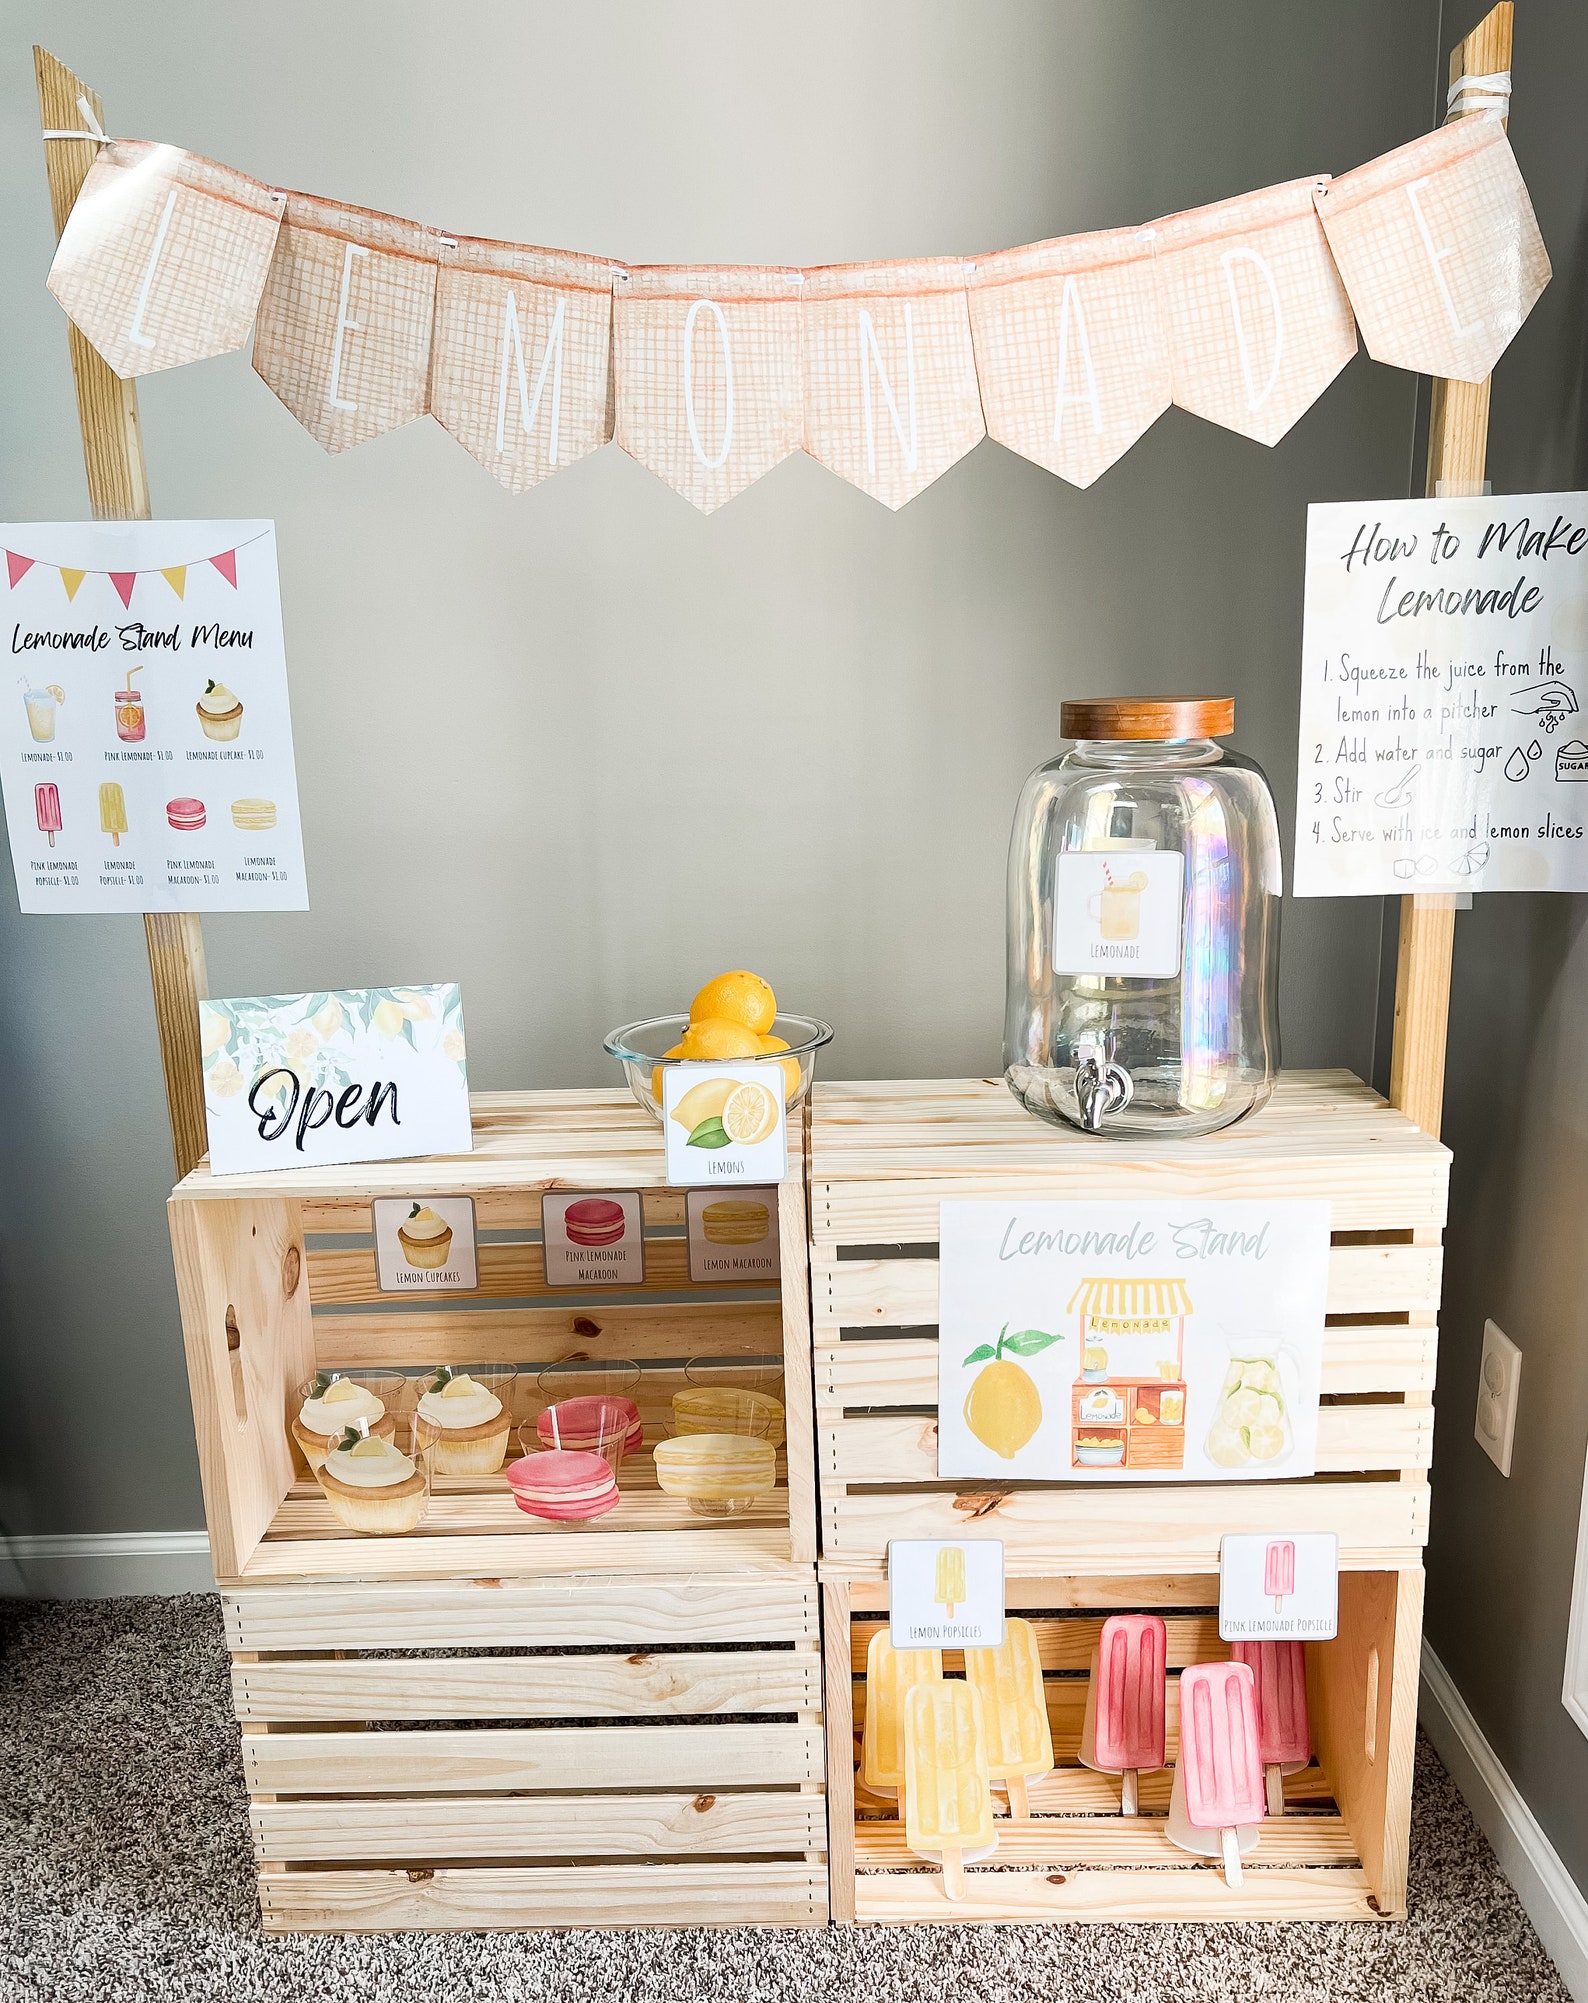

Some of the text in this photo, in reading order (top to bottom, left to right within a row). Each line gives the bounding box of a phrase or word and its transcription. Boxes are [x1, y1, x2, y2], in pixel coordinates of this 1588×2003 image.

[128, 174, 1484, 470] LEMONADE
[1340, 515, 1588, 572] How to Make
[1376, 576, 1544, 624] Lemonade
[11, 622, 253, 653] Lemonade Stand Menu
[1323, 645, 1565, 696] 1. Squeeze the juice from the
[1337, 690, 1499, 734] lemon into a pitcher
[21, 752, 73, 763] LEMONADE- $1.00
[104, 750, 173, 762] PINK LEMONADE- $1.00
[186, 750, 219, 761] LEMONADE
[248, 749, 264, 760] $1.00
[1314, 734, 1503, 774] 2. Add water and sugar
[1314, 776, 1363, 804] 3. Stir
[1312, 812, 1583, 844] 4. Serve with ice and lemon slices
[30, 861, 78, 871] PINK LEMONADE
[104, 860, 135, 870] LEMONADE
[167, 859, 214, 870] PINK LEMONADE
[244, 856, 276, 866] LEMONADE
[63, 876, 79, 885] $1.00
[99, 875, 143, 885] POPSICLE- $1.00
[167, 875, 219, 885] MACAROON- $1.00
[236, 871, 287, 881] MACAROON- $1.00
[1090, 942, 1140, 959] LEMONADE
[248, 1068, 401, 1152] Open
[708, 1160, 745, 1175] LEMONS
[999, 1216, 1271, 1260] Lemonade Stand
[565, 1249, 627, 1263] PINK LEMONADE
[703, 1255, 772, 1272] LEMON MACAROON
[396, 1269, 461, 1284] LEMON CUPCAKES
[578, 1267, 618, 1281] MACAROON
[909, 1625, 983, 1640] LEMON POPSICLES
[1224, 1617, 1333, 1633] PINK LEMONADE POPSICLE
